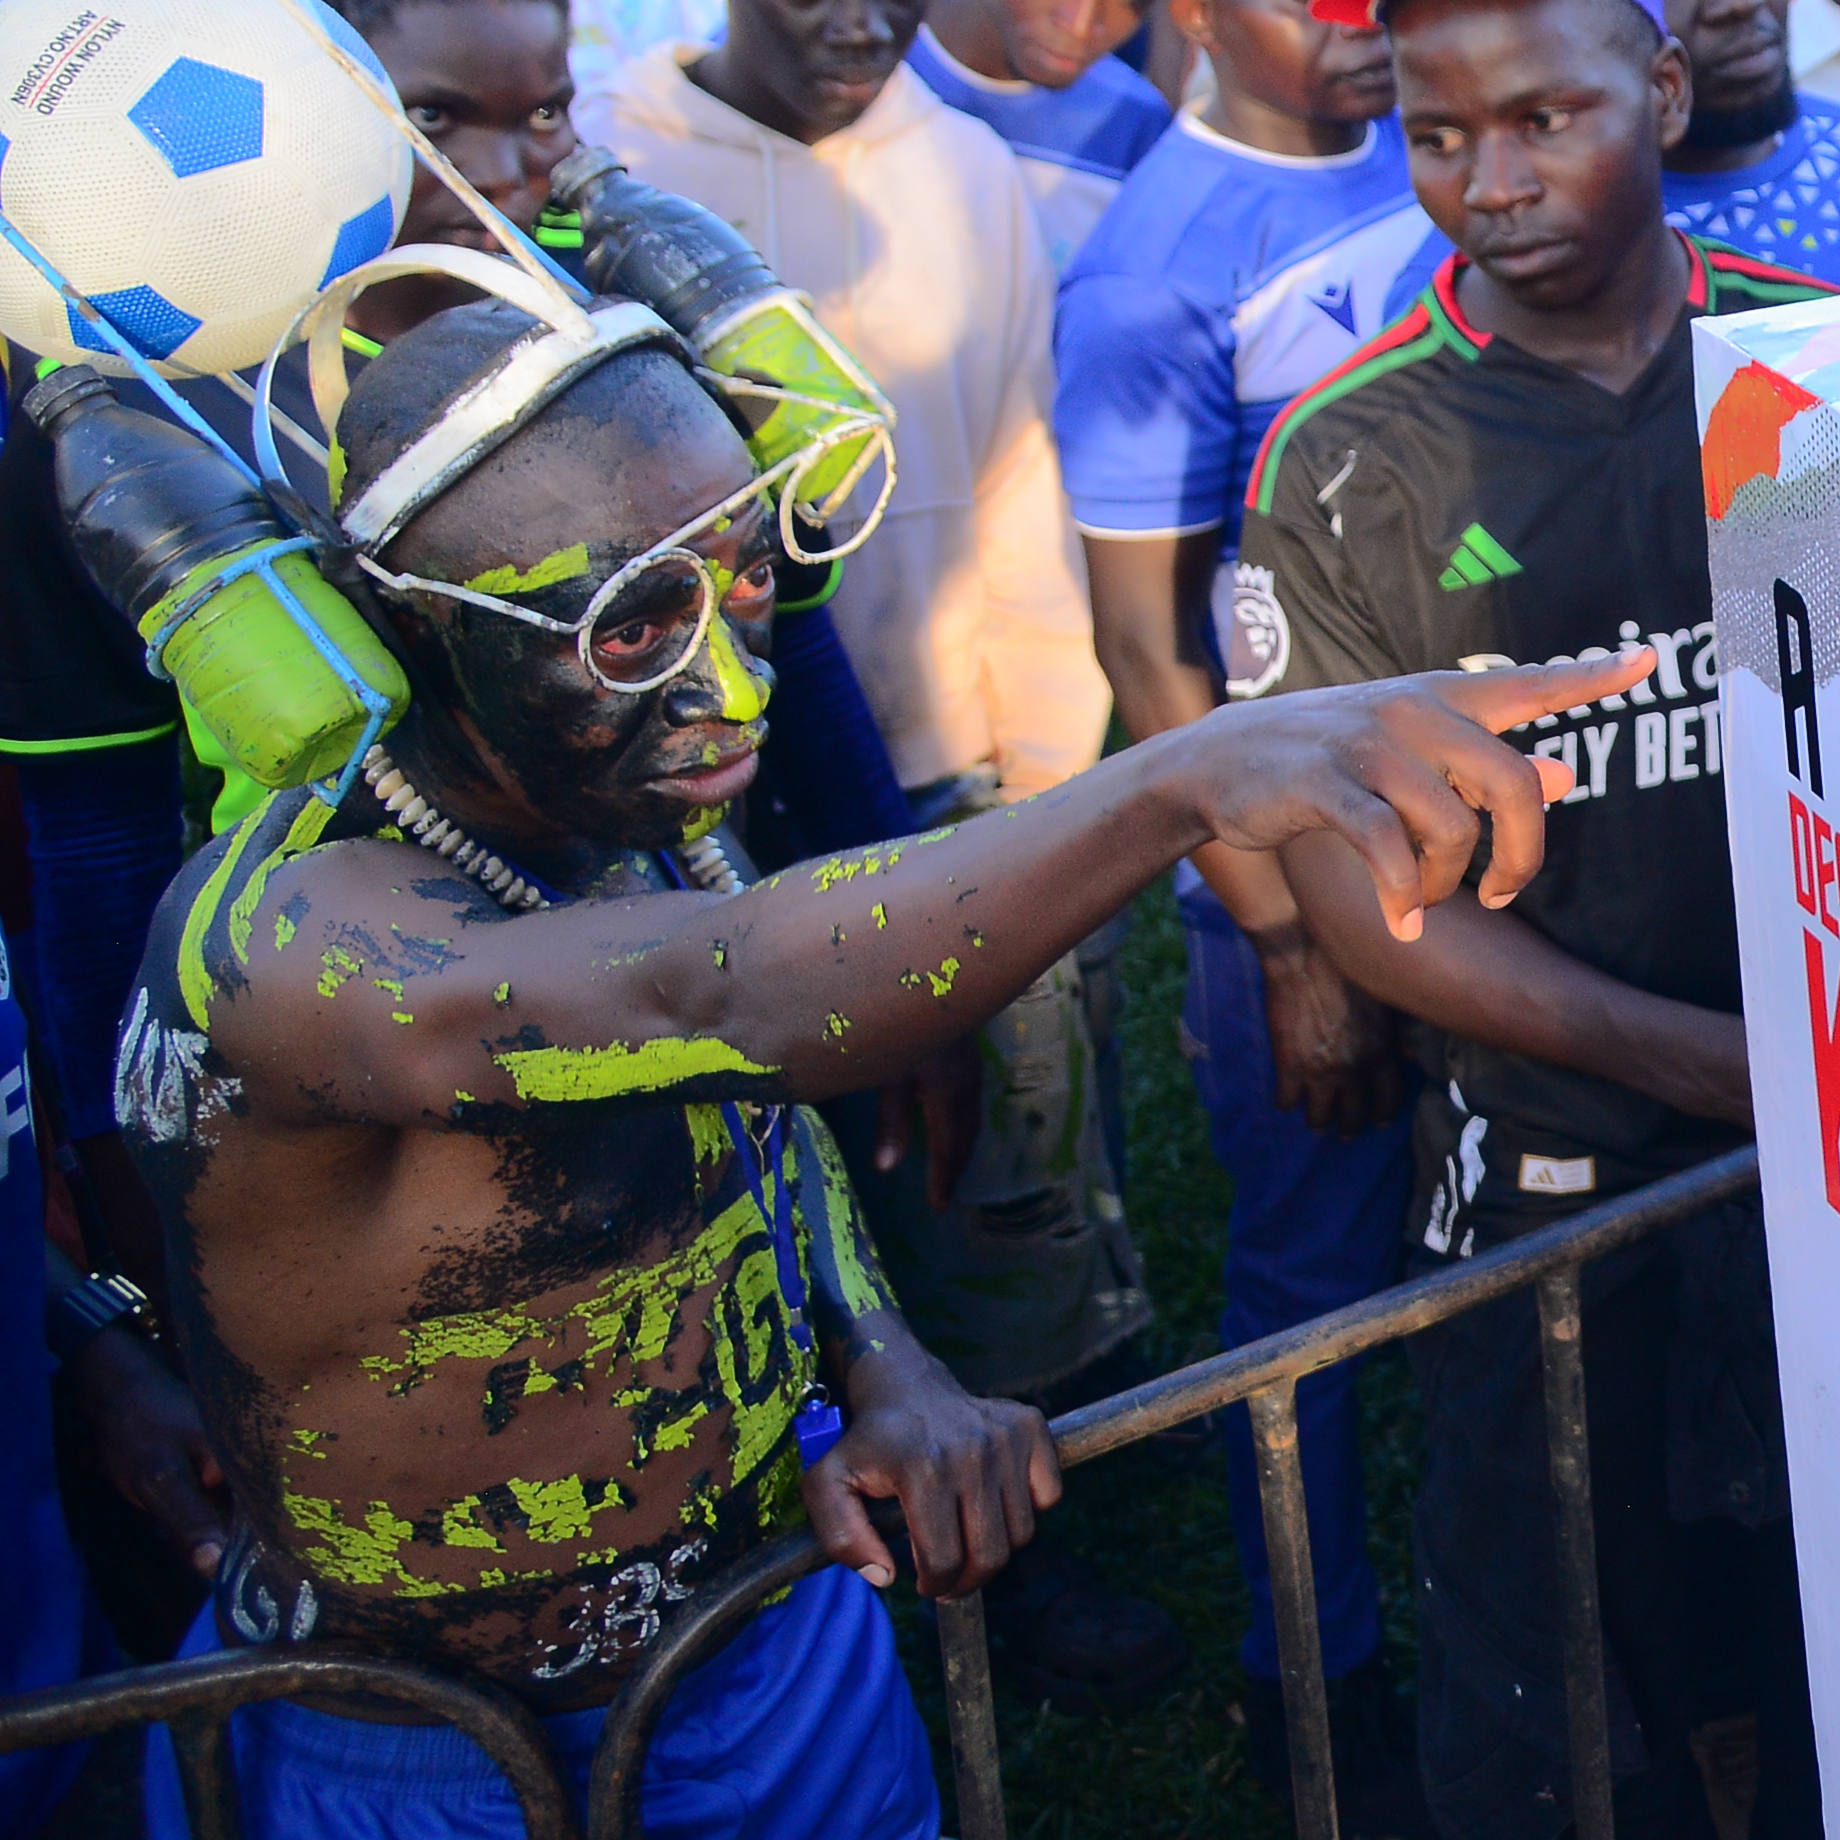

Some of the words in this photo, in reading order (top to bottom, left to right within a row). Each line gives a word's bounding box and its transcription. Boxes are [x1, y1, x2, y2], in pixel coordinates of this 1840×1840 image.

[76, 18, 126, 63] NYLON
[36, 62, 85, 116] WOUND
[1773, 577, 1824, 801] A
